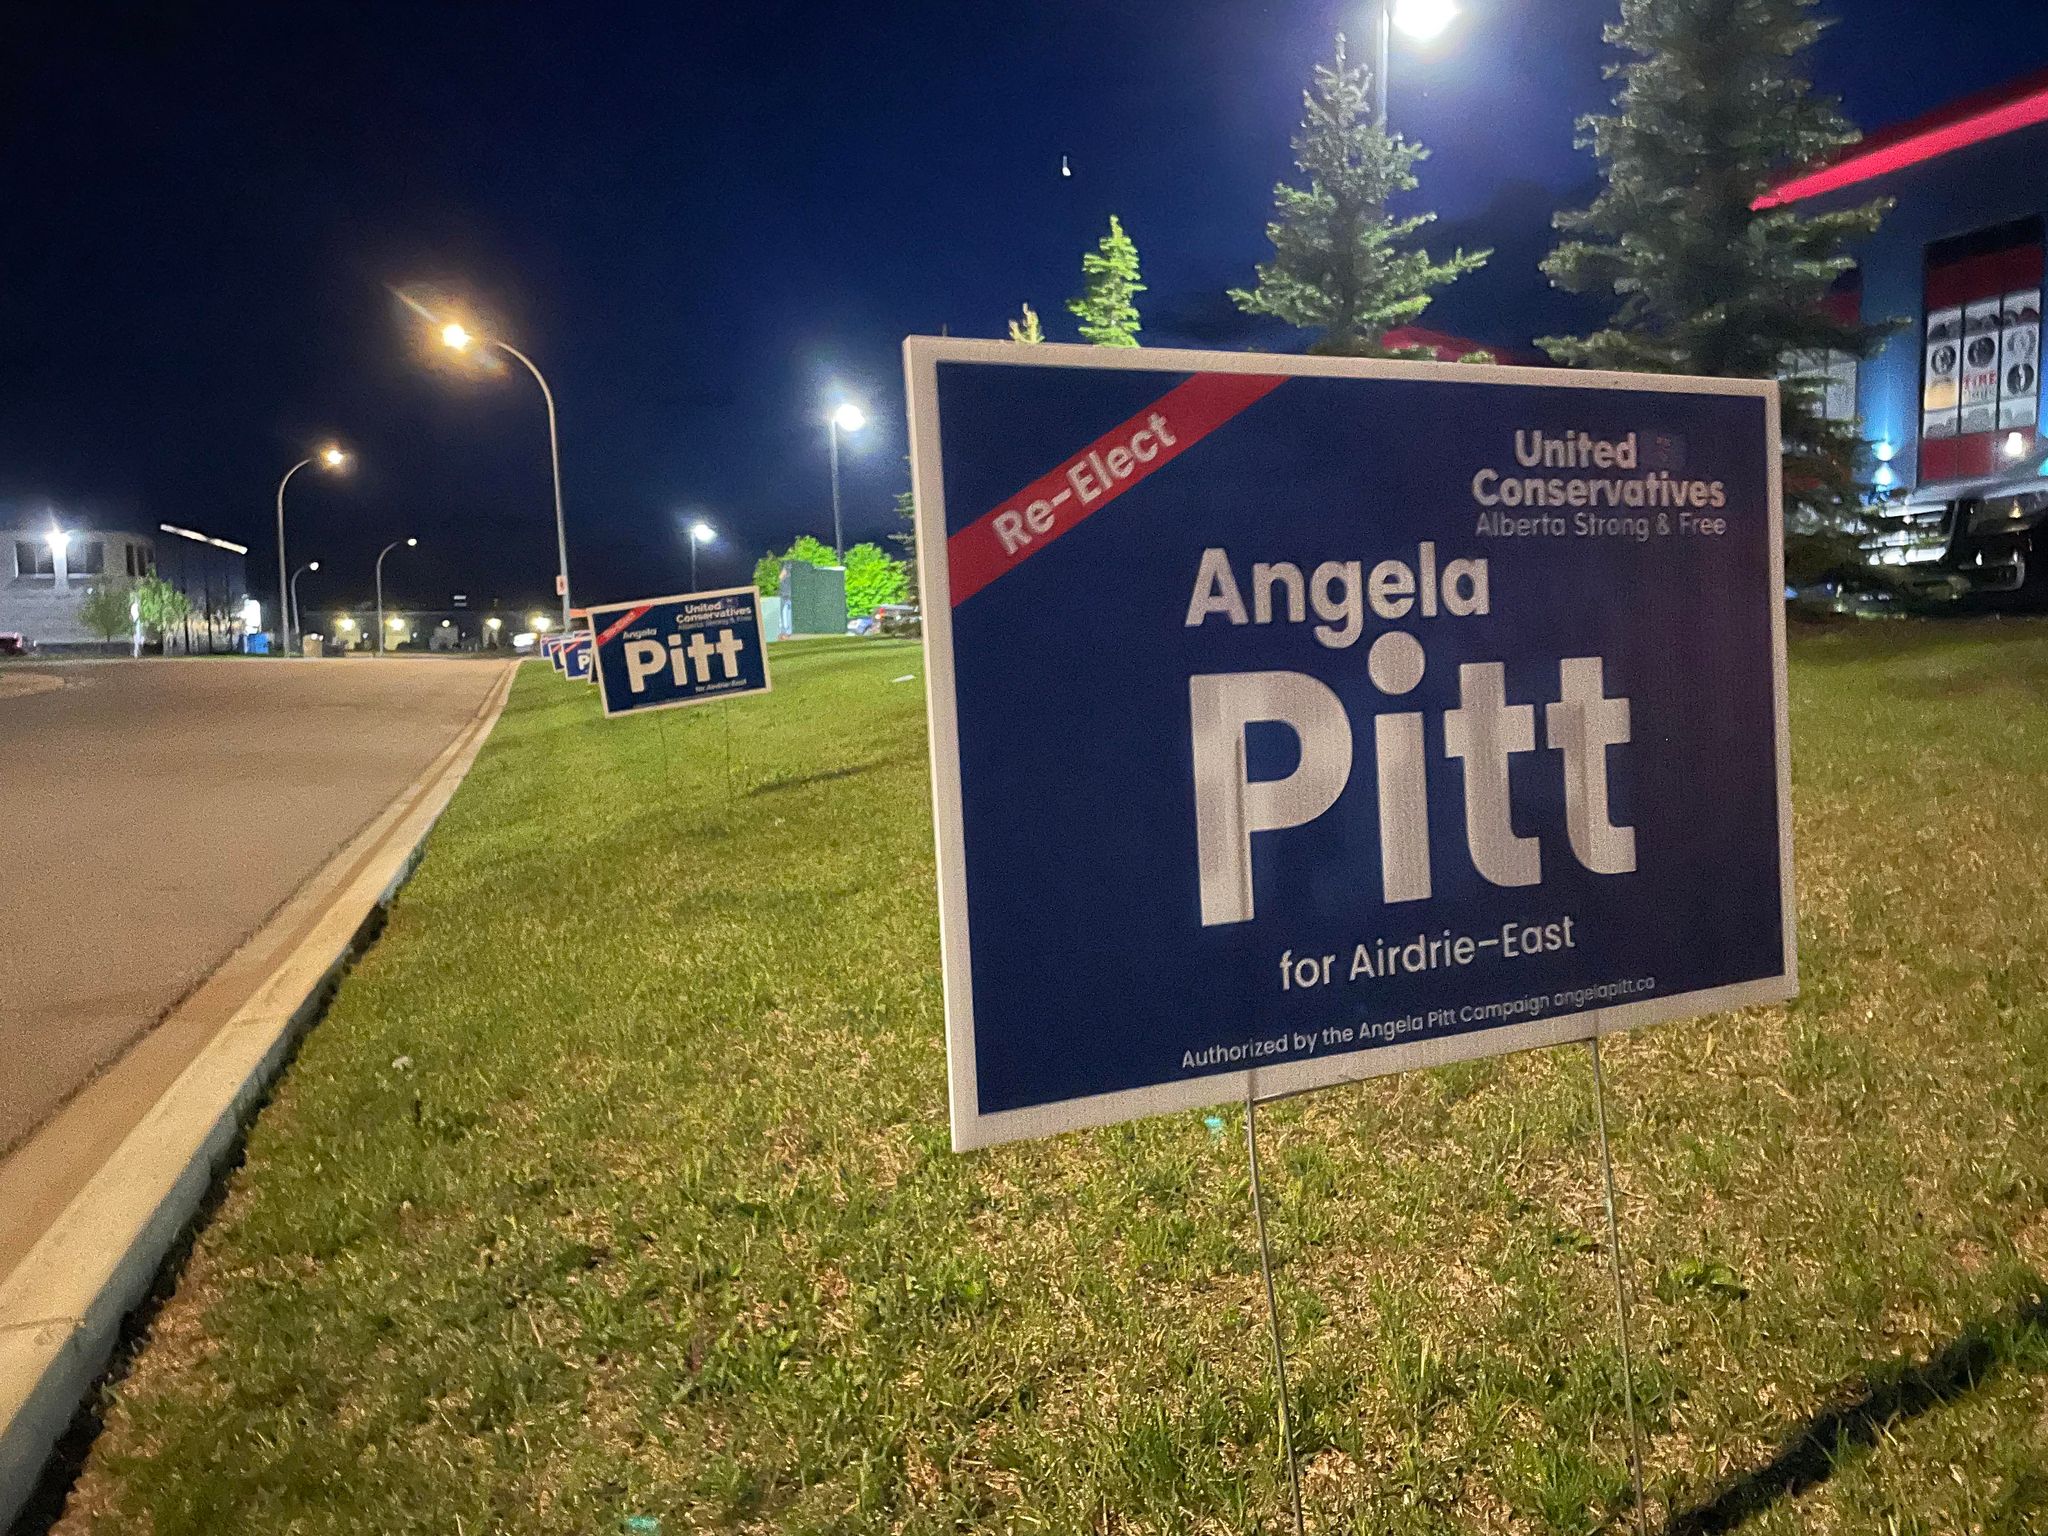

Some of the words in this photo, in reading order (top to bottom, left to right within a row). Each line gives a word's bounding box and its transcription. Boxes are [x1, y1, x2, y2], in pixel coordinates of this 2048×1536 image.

[992, 411, 1177, 555] Re-Elect
[1515, 428, 1638, 470] United
[1471, 467, 1727, 508] Conservatives
[1475, 510, 1566, 538] Alberta
[1574, 511, 1650, 542] Strong
[1655, 511, 1671, 537] &
[1678, 511, 1727, 536] Free
[684, 602, 721, 614] United
[1184, 541, 1491, 649] Angela
[624, 629, 743, 693] Pitt
[1189, 631, 1637, 927] Pitt
[1279, 949, 1336, 991] for
[1349, 915, 1575, 982] Airdrie-East
[1182, 1033, 1289, 1069] Authorized
[1293, 1031, 1318, 1054] by
[1322, 1026, 1354, 1046] the
[1358, 1015, 1423, 1041] Angela
[1427, 1008, 1457, 1029] Pitt
[1460, 993, 1550, 1022] Campaign
[1554, 976, 1656, 1008] angelapitt.ca
